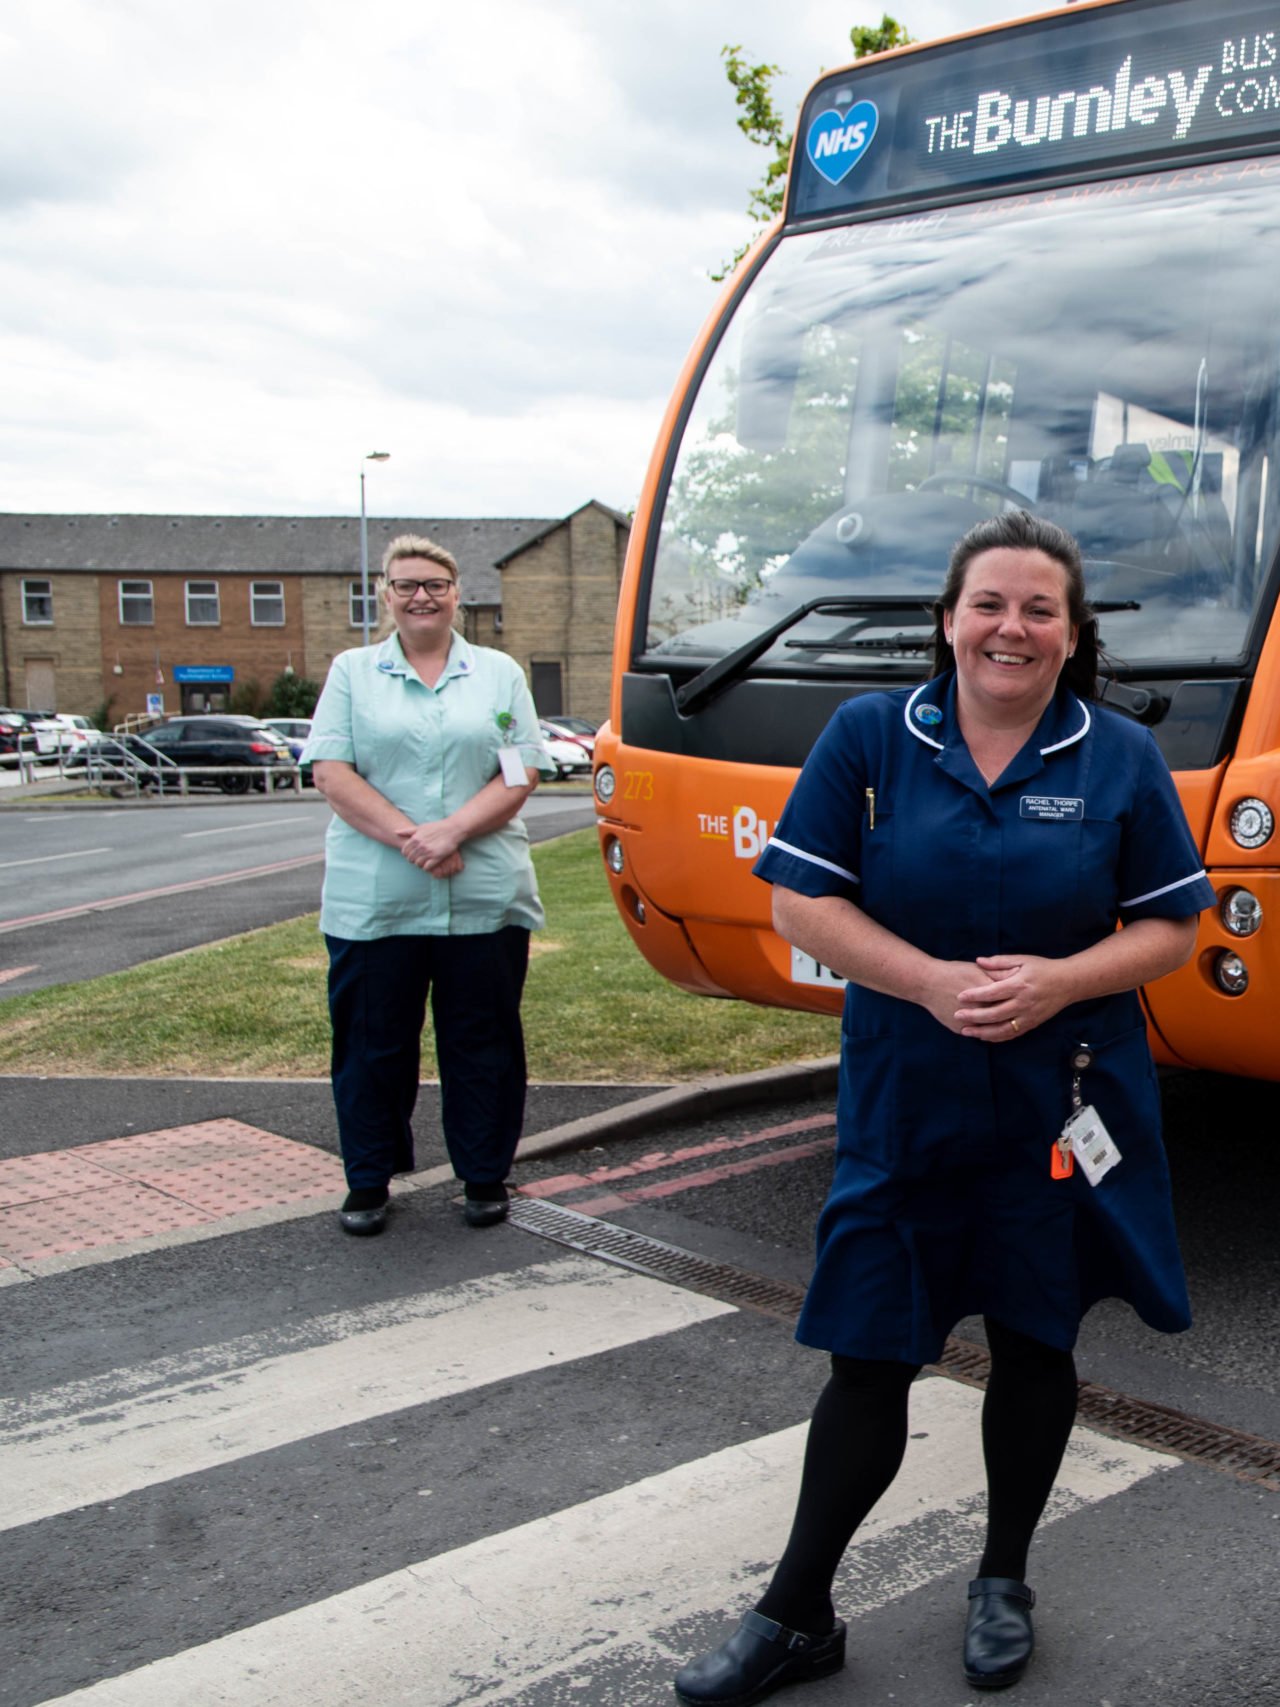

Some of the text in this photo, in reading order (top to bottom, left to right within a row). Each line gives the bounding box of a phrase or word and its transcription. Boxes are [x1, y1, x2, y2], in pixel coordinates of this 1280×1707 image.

[1222, 32, 1277, 74] BUS
[925, 55, 1213, 155] THE Burnley
[814, 121, 868, 159] NHS
[1070, 167, 1228, 202] WIRELESS
[623, 771, 654, 800] 273
[1026, 798, 1078, 807] RACHEL THORPE
[698, 814, 728, 835] THE
